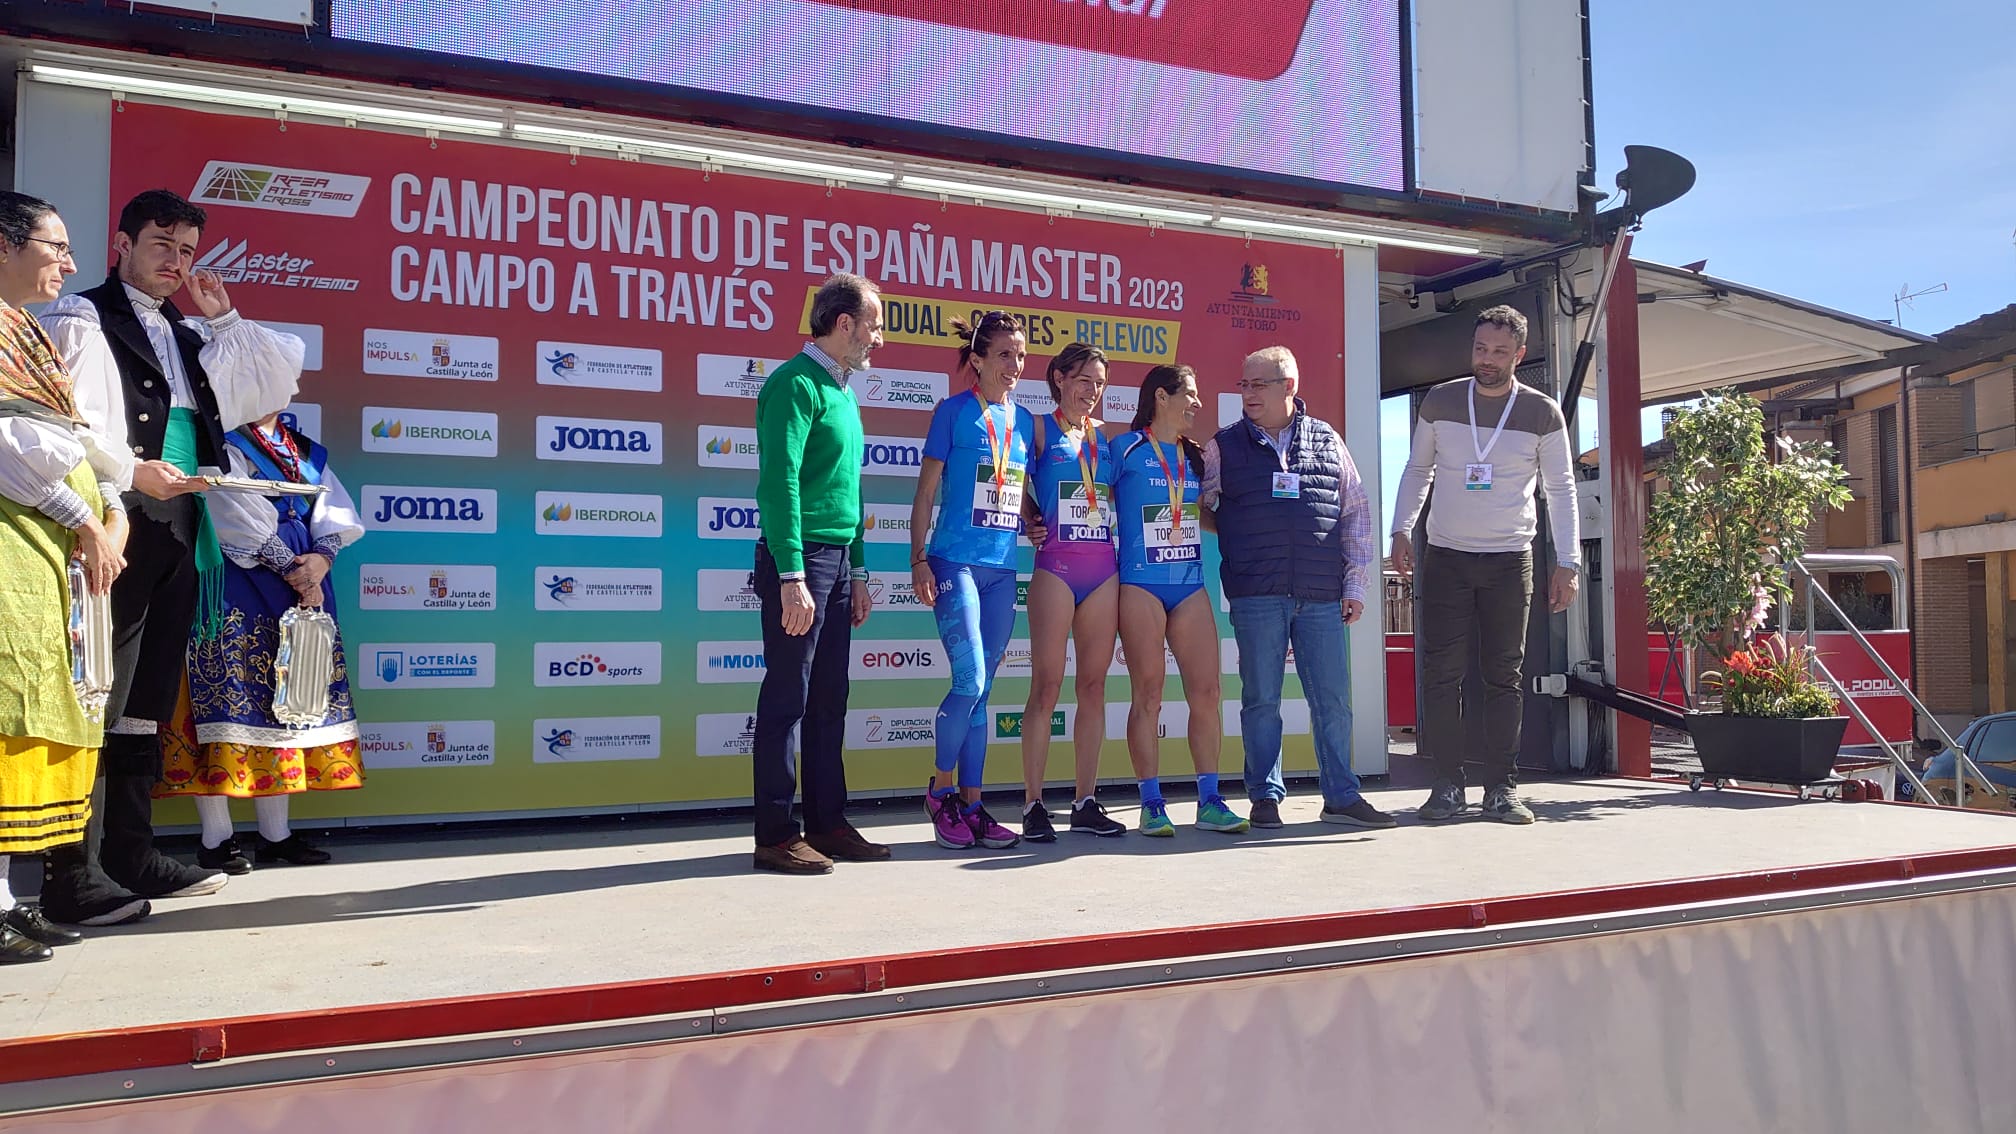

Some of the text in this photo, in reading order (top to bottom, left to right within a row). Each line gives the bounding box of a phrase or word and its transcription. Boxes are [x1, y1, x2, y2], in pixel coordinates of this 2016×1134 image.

[267, 187, 354, 201] ATLETISMO
[262, 195, 312, 206] CROSS
[390, 173, 1184, 312] CAMPEONATO DE ESPAÑA MASTER 2023
[244, 271, 359, 291] ATLETISMO
[390, 245, 774, 332] CAMPO A TRAVÉS
[1206, 303, 1301, 321] AYUNTAMIENTO
[1231, 317, 1277, 331] DE TORO
[1076, 319, 1168, 355] RELEVOS
[367, 341, 387, 349] NOS
[452, 360, 493, 369] Junta de
[426, 366, 493, 378] Castilla y León
[724, 381, 764, 390] AYUNTAM
[887, 392, 934, 405] ZAMORA
[1107, 402, 1137, 412] IMPULS
[405, 425, 492, 442] IBERDROLA
[575, 508, 656, 523] IBERDROLA
[449, 590, 491, 599] Junta de
[423, 598, 491, 609] Castilla y León
[409, 653, 477, 665] LOTERÍAS
[549, 661, 643, 678] BCD sports
[361, 733, 381, 741] NOS
[887, 730, 934, 741] ZAMORA
[447, 743, 489, 753] Junta de
[421, 750, 489, 763] Castilla y León
